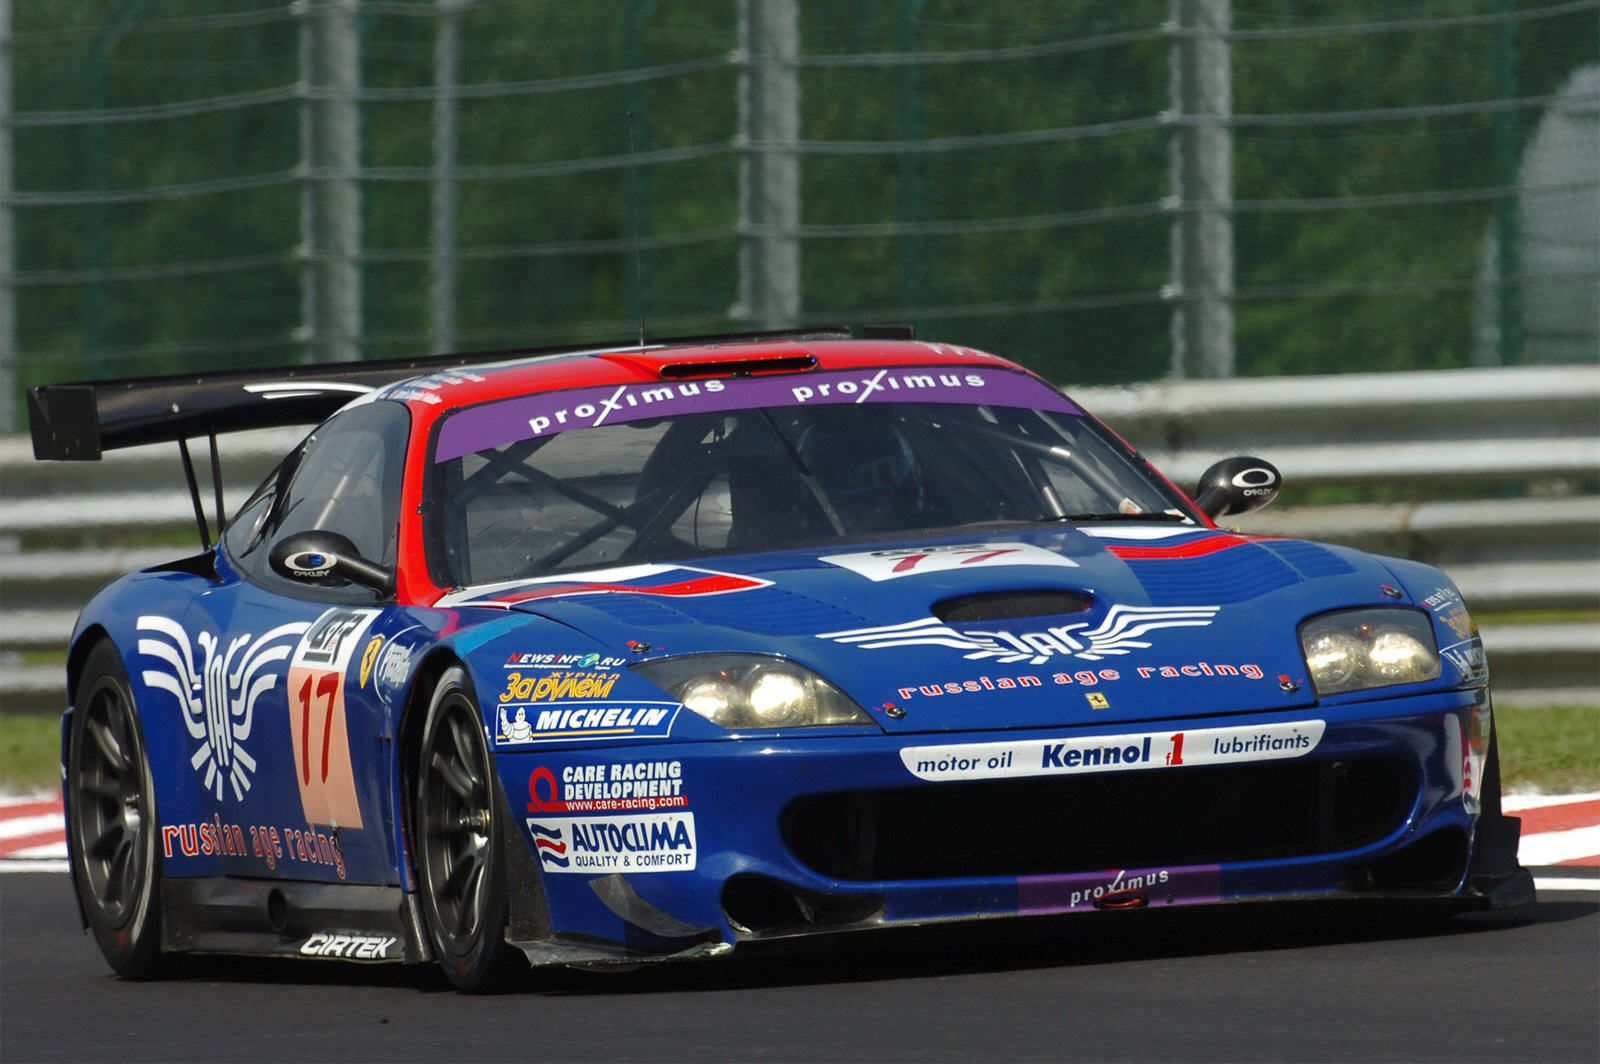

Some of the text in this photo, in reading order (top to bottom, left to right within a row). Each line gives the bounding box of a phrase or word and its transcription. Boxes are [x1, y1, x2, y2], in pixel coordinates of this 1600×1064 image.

[792, 370, 986, 404] proximus
[528, 380, 726, 434] proximus
[293, 570, 330, 578] OAKLEY
[499, 672, 535, 703] За
[898, 662, 1264, 699] russian age racing
[299, 672, 339, 787] 17
[536, 708, 669, 730] MICHELIN
[917, 755, 977, 773] motor
[987, 751, 1012, 768] oil
[1041, 738, 1151, 768] Kennol
[1213, 734, 1310, 754] lubrifiants
[563, 761, 681, 783] CARE RACING
[564, 779, 683, 801] DEVELOPMENT
[566, 796, 684, 811] www.care-racing.com
[162, 813, 346, 880] russian age racing
[571, 820, 693, 853] AUTOCLIMA
[575, 853, 691, 867] QUALITY & COMFORT
[1070, 870, 1169, 907] proximus
[300, 933, 397, 958] CIRTEK
